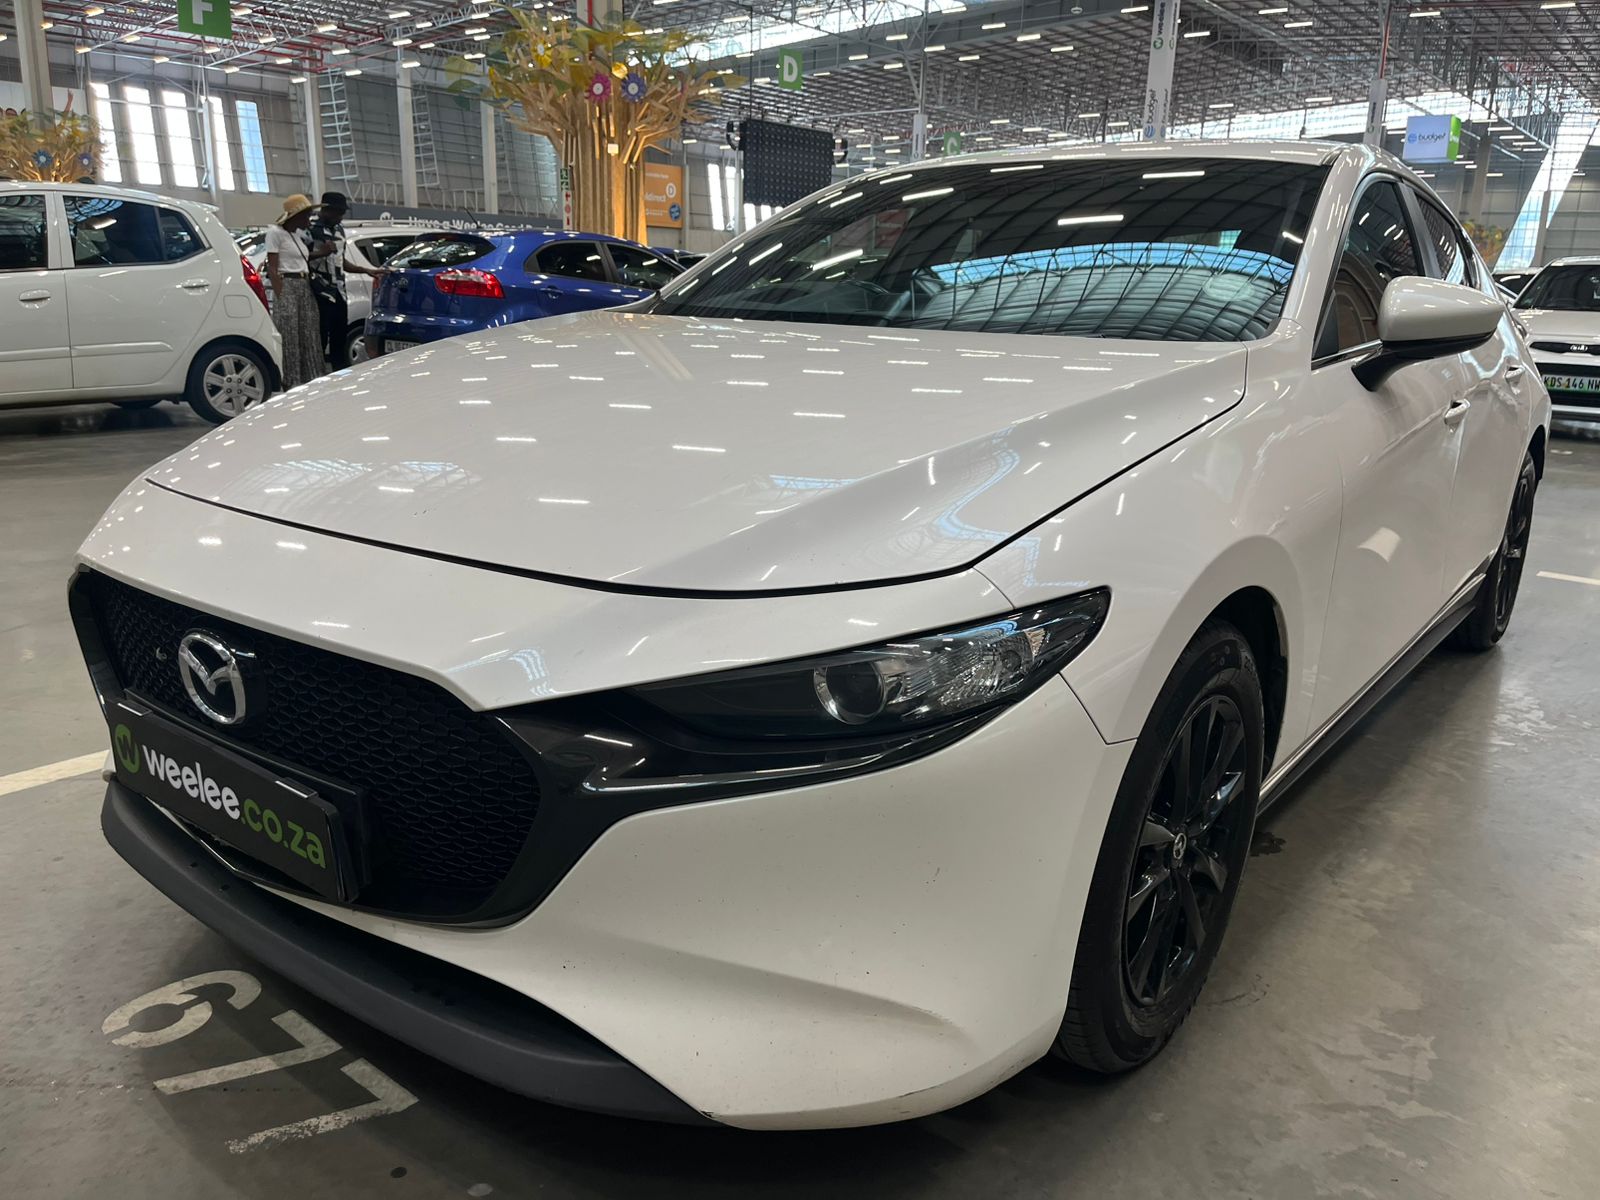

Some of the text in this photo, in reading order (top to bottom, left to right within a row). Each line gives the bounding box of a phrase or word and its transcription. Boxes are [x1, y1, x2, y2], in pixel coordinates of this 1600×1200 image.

[192, 0, 214, 25] F
[783, 55, 798, 83] D
[947, 137, 957, 155] C
[1418, 132, 1447, 143] budget
[1543, 376, 1563, 388] KDS
[1565, 377, 1585, 389] 146
[142, 744, 327, 869] weelee.co.za
[101, 970, 420, 1153] 677
